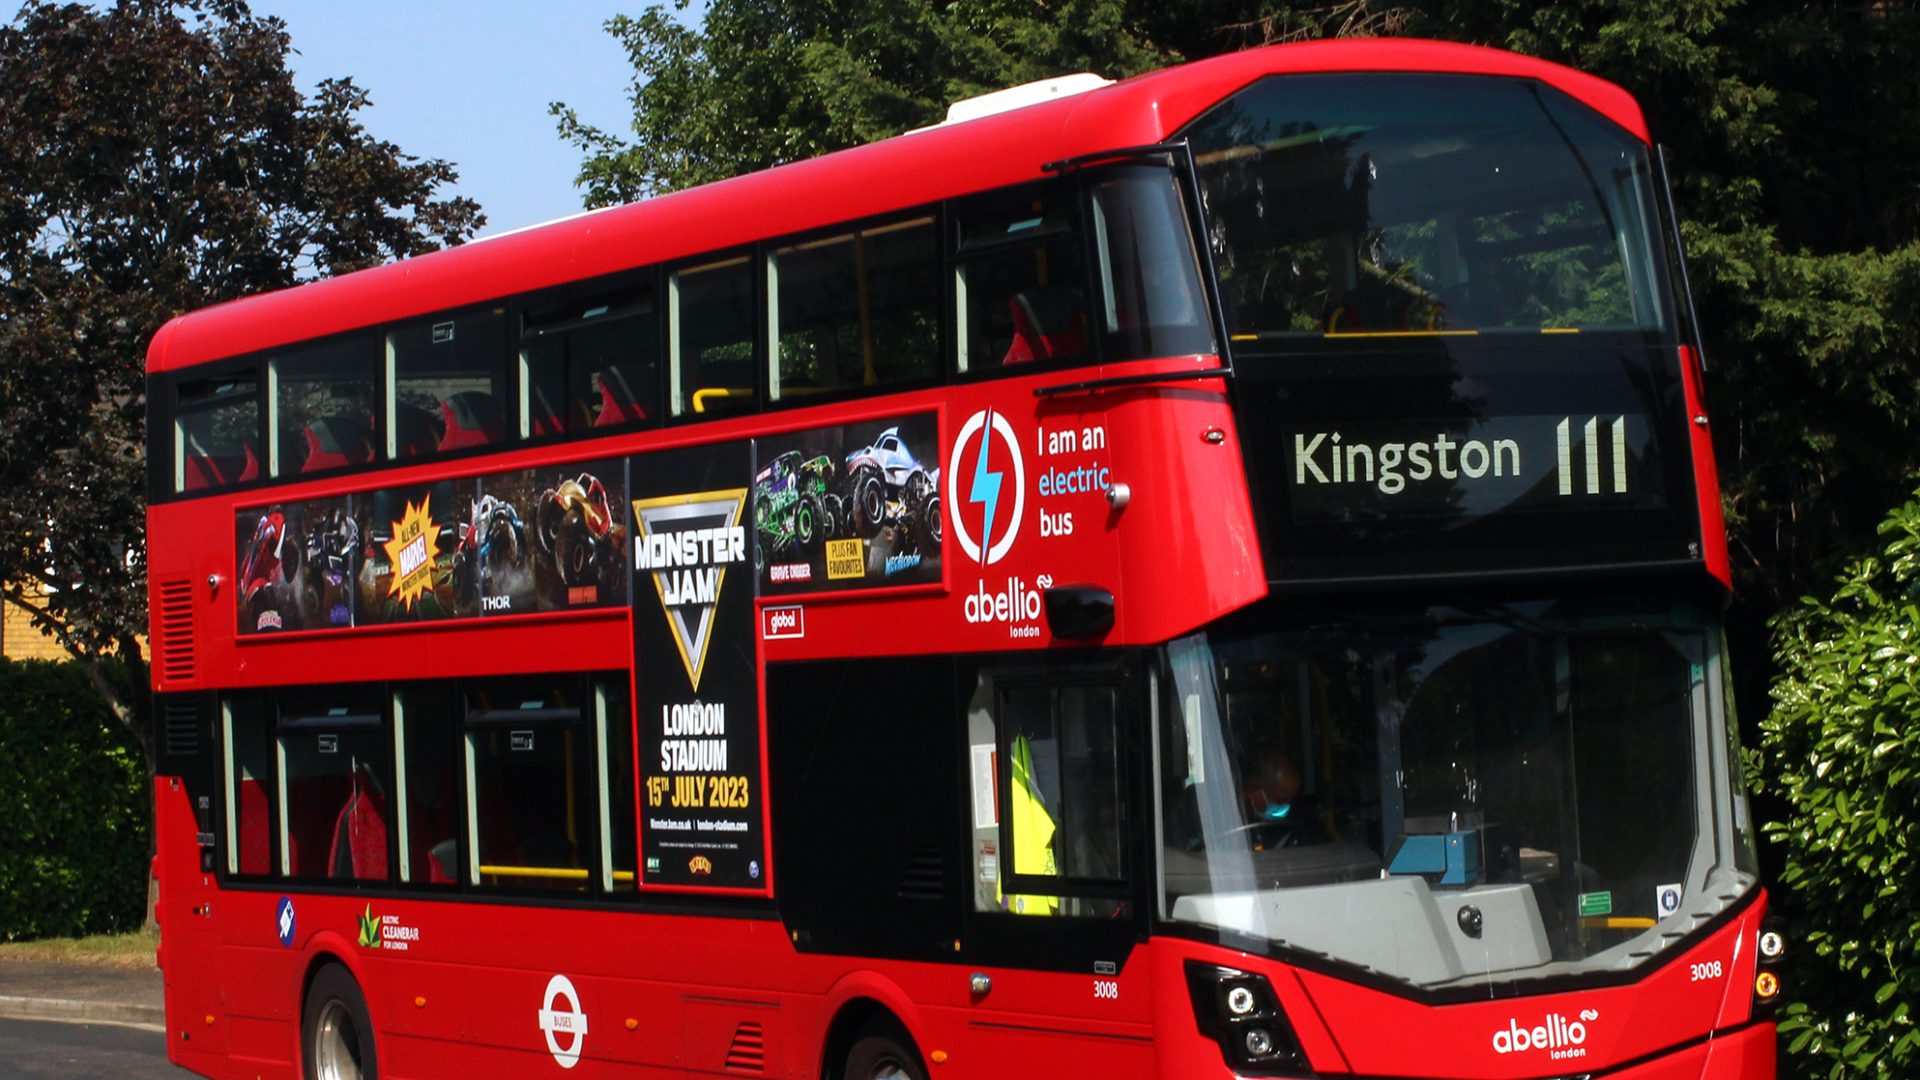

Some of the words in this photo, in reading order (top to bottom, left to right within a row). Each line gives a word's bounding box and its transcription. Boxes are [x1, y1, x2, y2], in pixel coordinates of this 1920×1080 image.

[1038, 427, 1043, 456] I
[1048, 431, 1076, 453] am
[1082, 426, 1105, 451] an
[1557, 415, 1627, 496] 111
[1295, 431, 1521, 495] Kingston
[1039, 462, 1110, 496] electric
[401, 520, 420, 544] ALL-NEW
[1040, 508, 1073, 537] bus
[399, 535, 427, 577] MARVEL
[634, 526, 746, 570] MONSTER
[832, 543, 846, 557] PLUS
[846, 541, 857, 555] FAN
[829, 559, 863, 576] FAVOURITES
[663, 569, 715, 605] JAM
[964, 577, 1041, 623] abellio
[482, 595, 511, 611] THOR
[770, 611, 796, 634] global
[1010, 625, 1040, 638] london
[663, 703, 725, 736] LONDON
[660, 740, 728, 771] STADIUM
[647, 776, 670, 807] 15TH
[671, 777, 706, 807] JULY
[709, 777, 749, 808] 2023
[1690, 960, 1722, 981] 3008
[1093, 981, 1119, 999] 3008
[554, 1015, 572, 1028] BUSES
[1493, 1014, 1586, 1054] abellio
[1550, 1047, 1586, 1060] london
